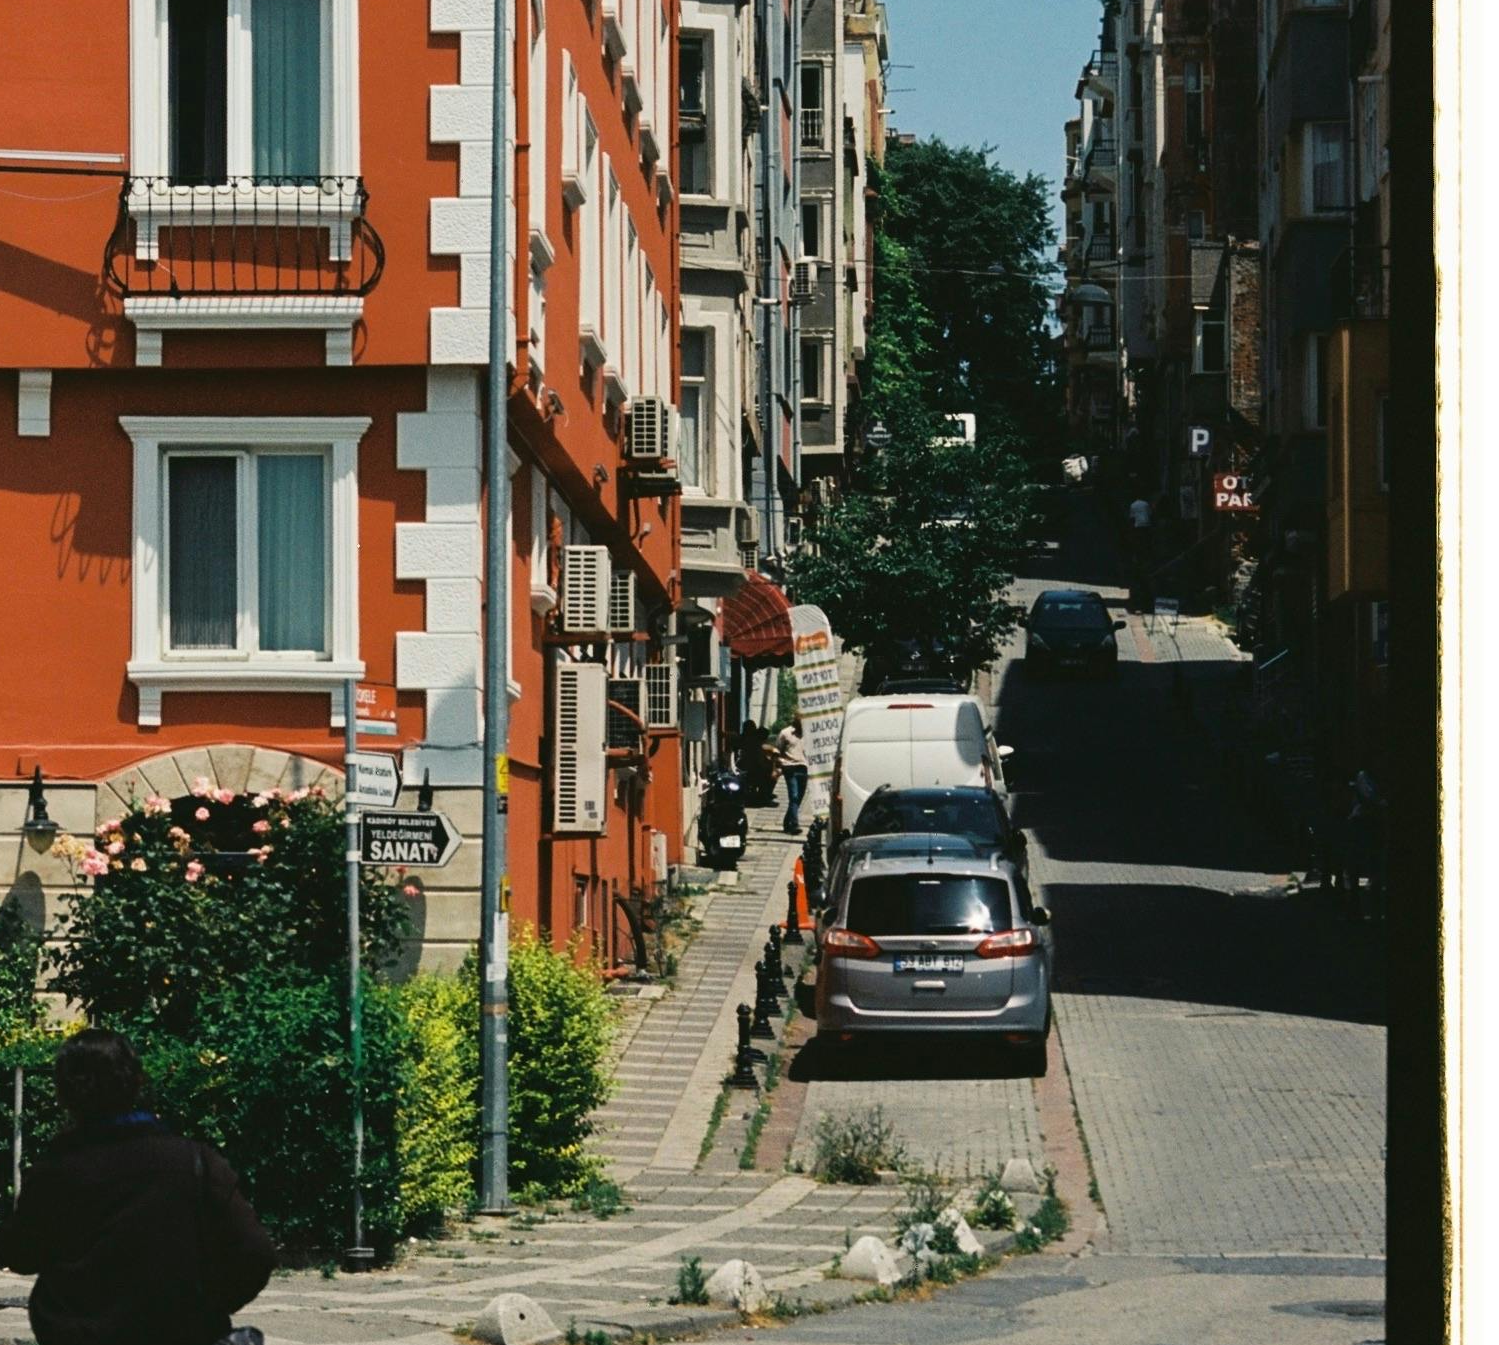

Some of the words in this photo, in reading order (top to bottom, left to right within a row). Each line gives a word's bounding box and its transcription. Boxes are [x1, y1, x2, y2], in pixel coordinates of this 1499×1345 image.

[1191, 428, 1210, 453] P
[366, 816, 396, 825] KADIKÖY
[370, 840, 434, 862] SANAT
